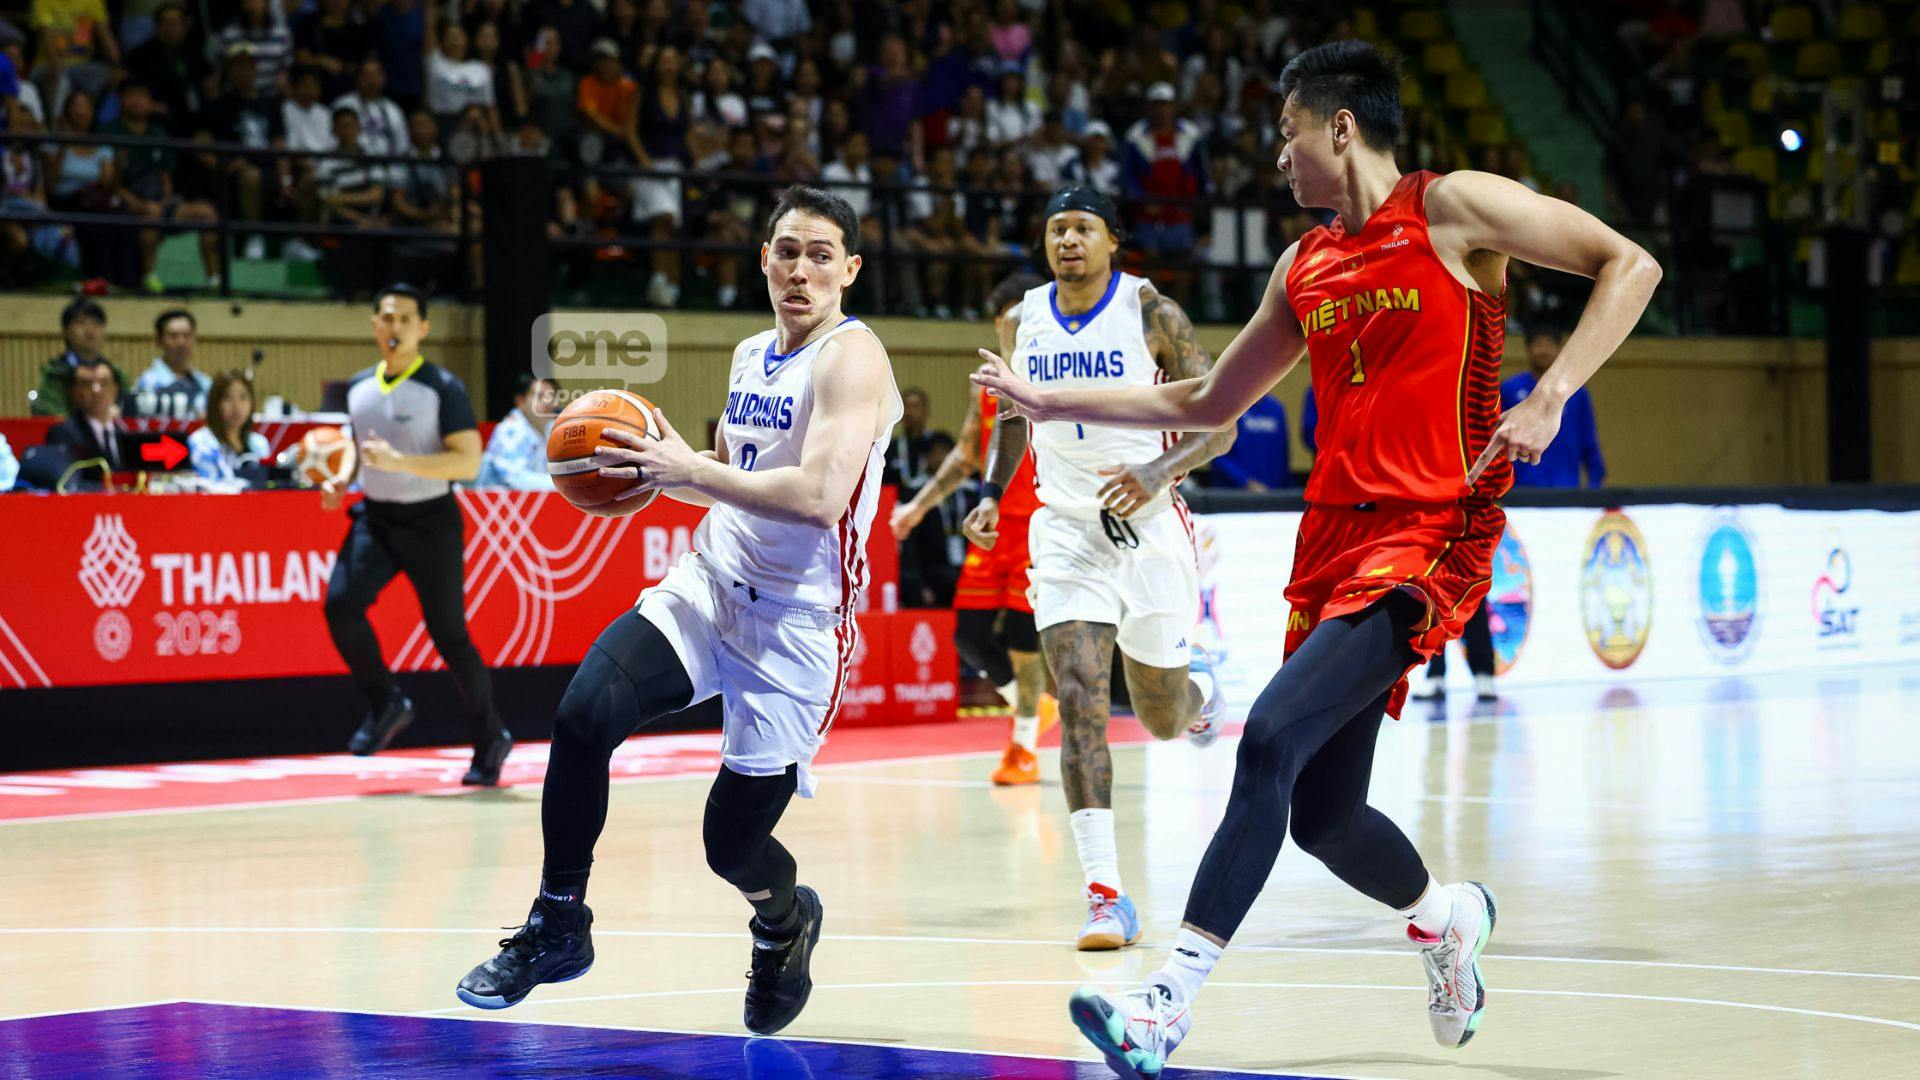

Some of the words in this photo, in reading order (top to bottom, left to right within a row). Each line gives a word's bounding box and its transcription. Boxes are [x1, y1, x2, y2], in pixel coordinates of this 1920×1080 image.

[1381, 239, 1409, 250] THAILAND
[1355, 287, 1420, 316] NAM
[1028, 350, 1124, 382] PILIPINAS
[1350, 339, 1365, 383] 1
[563, 425, 586, 440] FIBA
[151, 551, 338, 606] THAILAN
[153, 609, 242, 657] 2025
